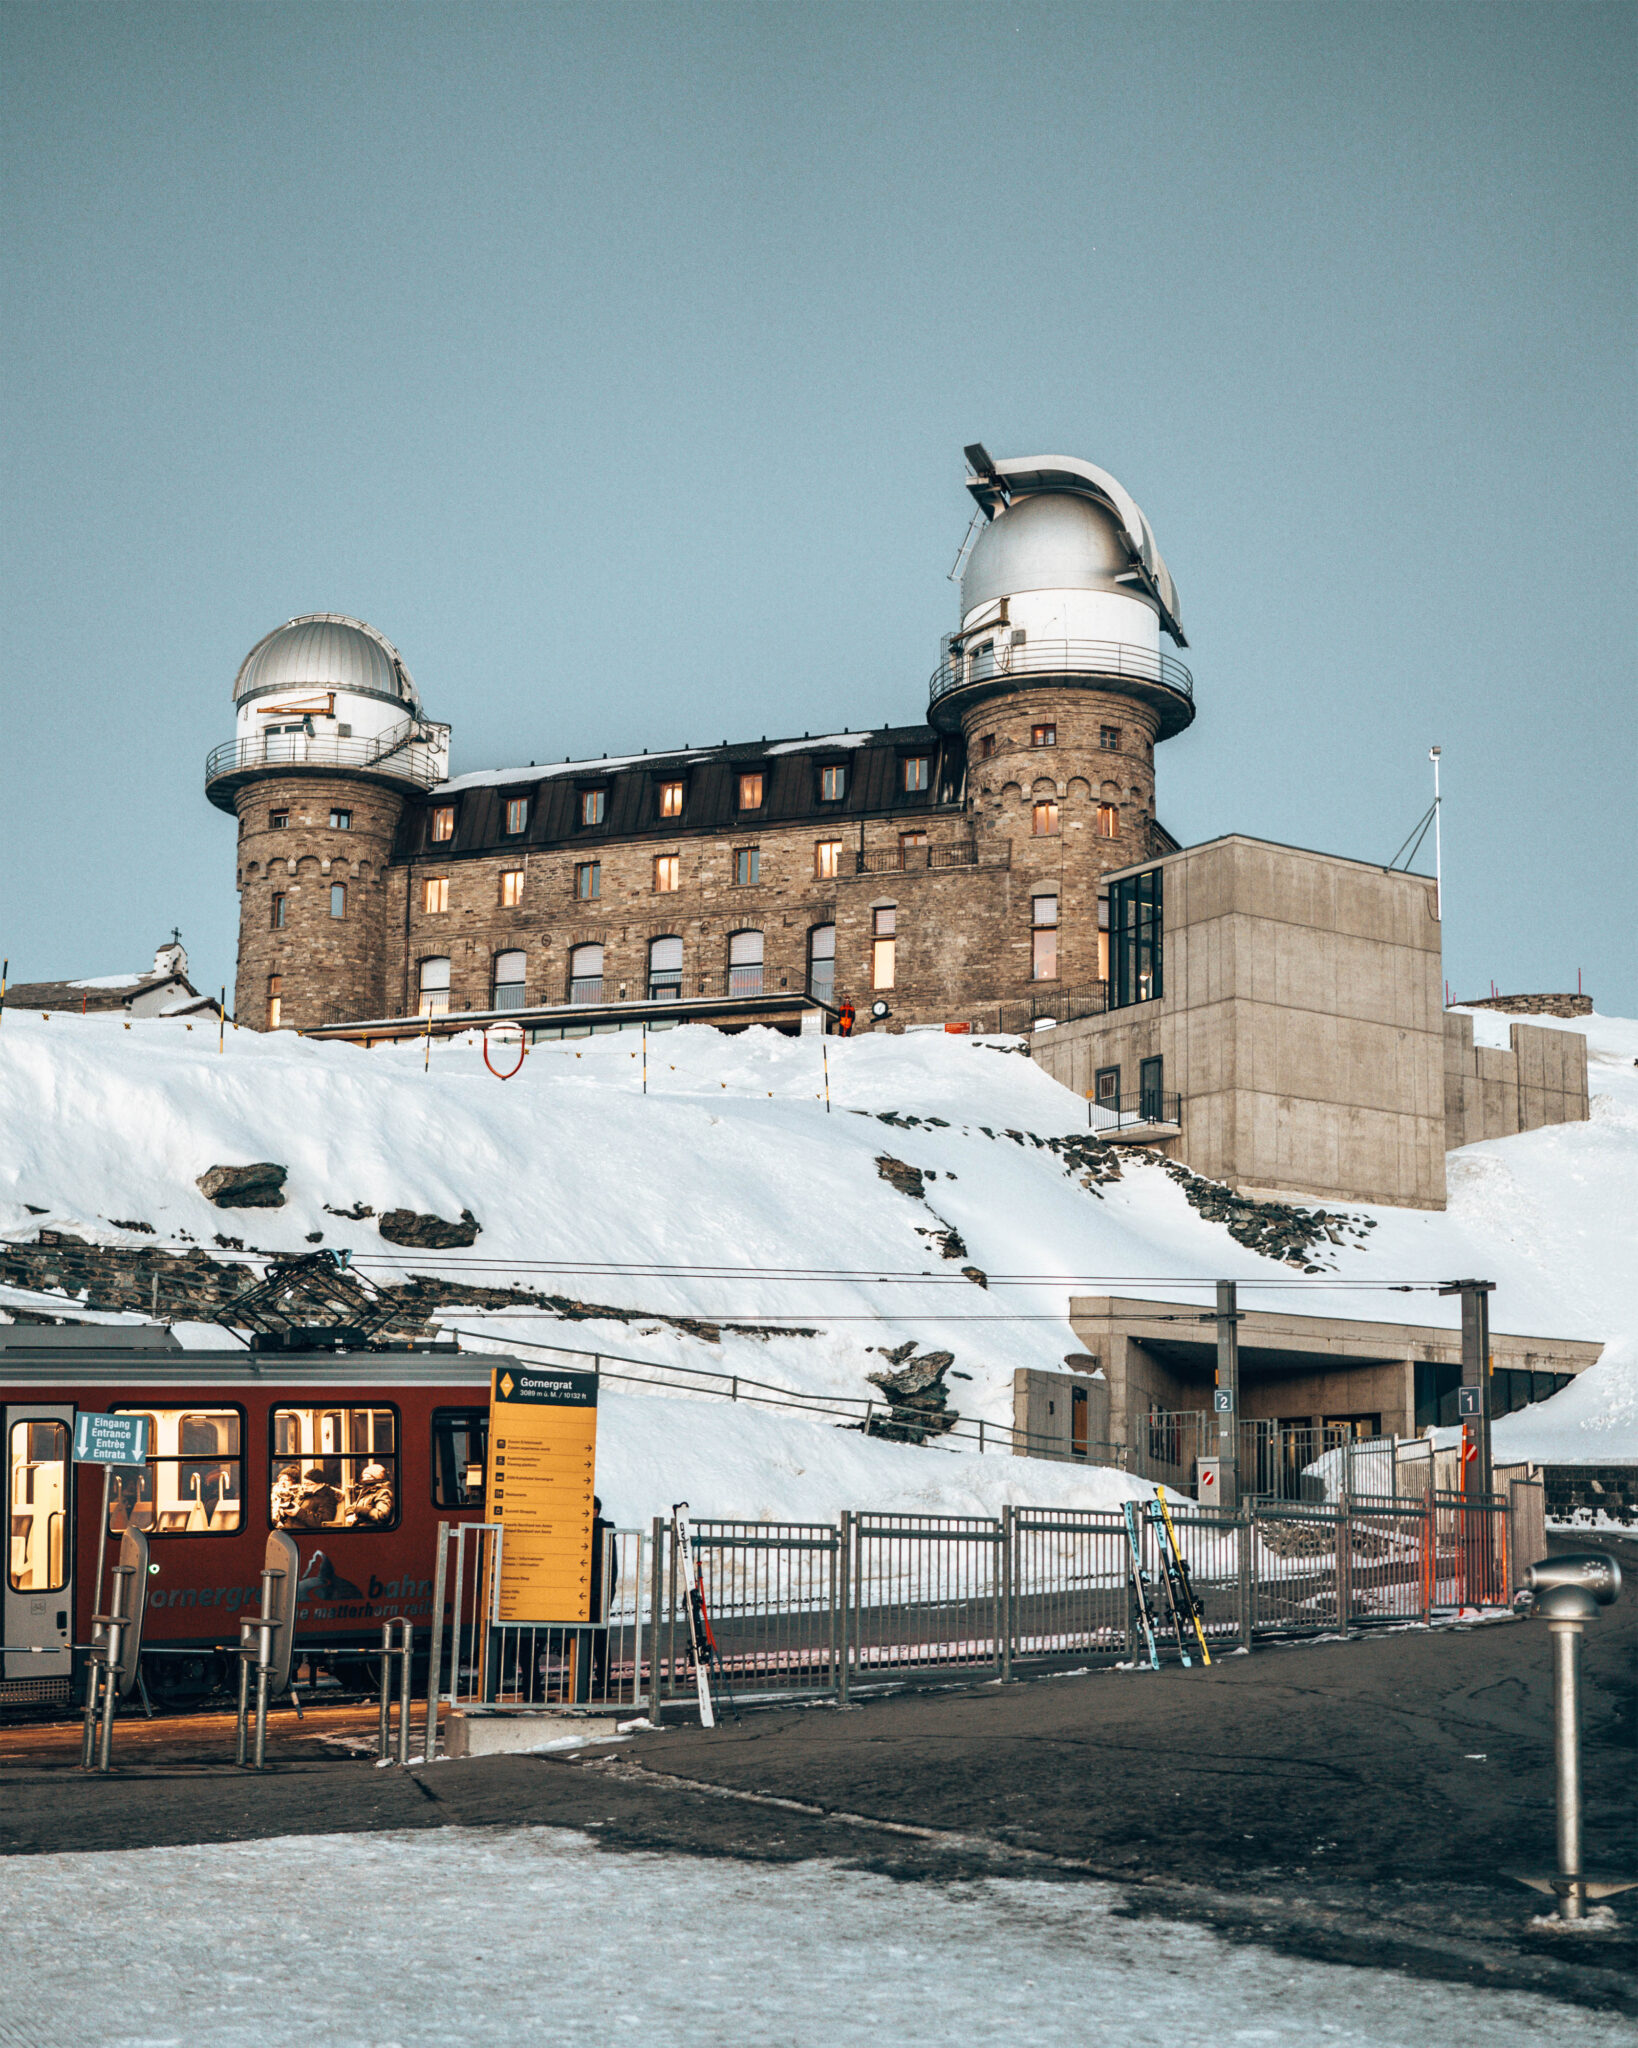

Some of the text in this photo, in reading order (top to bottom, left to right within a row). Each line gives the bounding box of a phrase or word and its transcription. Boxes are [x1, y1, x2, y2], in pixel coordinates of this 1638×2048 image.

[520, 1377, 573, 1391] Gornergrat
[520, 1389, 536, 1397] 3089
[1220, 1396, 1228, 1409] 2
[1466, 1395, 1473, 1411] 1
[94, 1417, 131, 1431] Eingang
[92, 1428, 132, 1439] Entrance
[93, 1448, 126, 1459] Entrata
[368, 1573, 433, 1599] bahn
[313, 1602, 400, 1620] matterhorn
